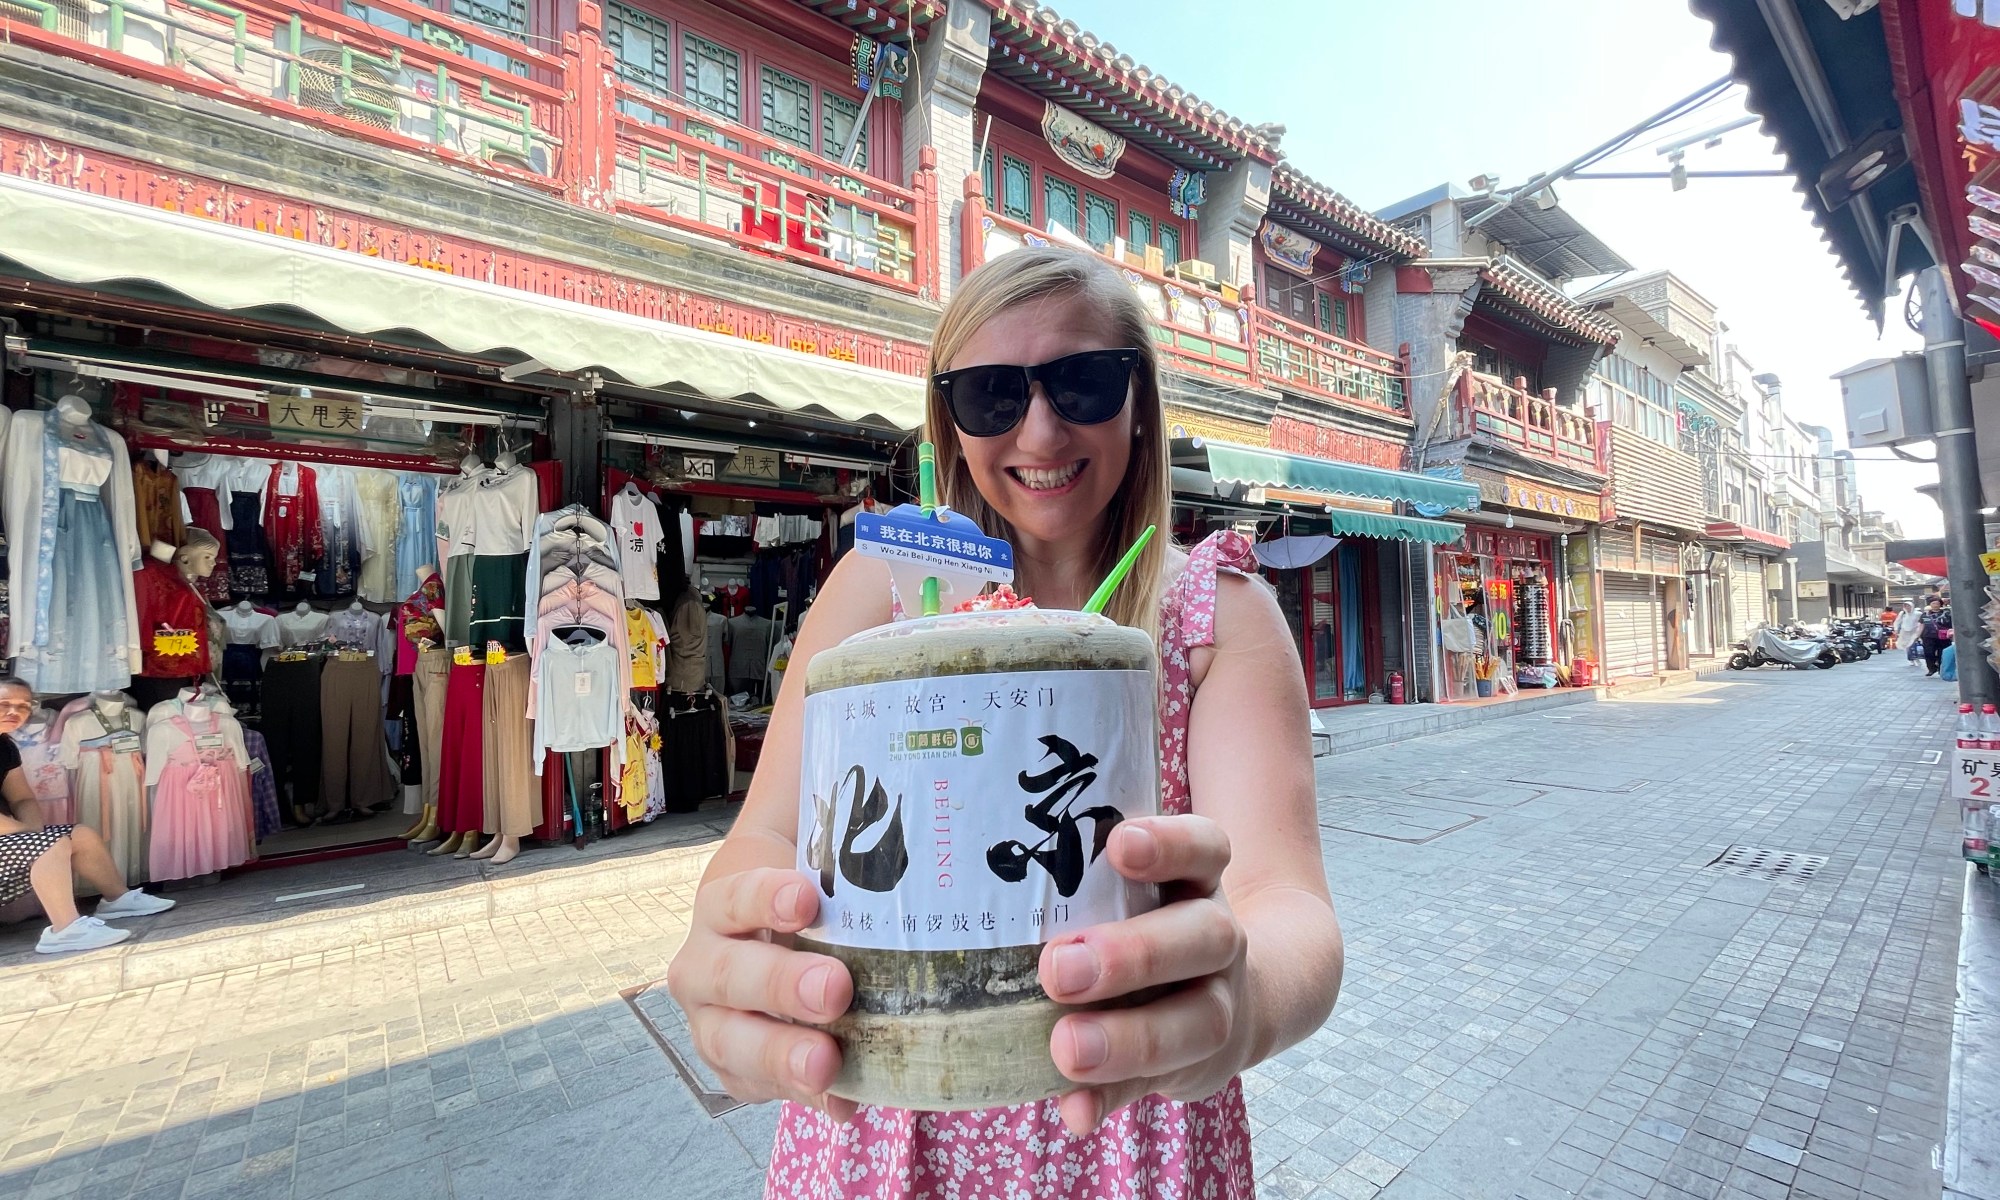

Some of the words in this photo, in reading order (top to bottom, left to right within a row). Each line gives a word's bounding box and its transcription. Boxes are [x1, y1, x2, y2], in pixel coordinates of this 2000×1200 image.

[420, 84, 437, 96] TC
[278, 402, 361, 430] 大甩卖
[686, 459, 714, 477] 入口
[860, 524, 870, 534] 南
[879, 525, 993, 560] 我在北京很想你
[880, 546, 895, 555] Wo
[896, 549, 909, 558] Zai
[911, 551, 924, 561] Bei
[925, 554, 943, 566] Jing
[944, 558, 960, 568] Hen
[961, 561, 983, 574] Xiang
[984, 566, 994, 575] Ni
[1489, 582, 1507, 600] 全场
[922, 751, 941, 760] XIAN
[942, 750, 958, 759] CHA
[933, 778, 954, 890] BEIJING
